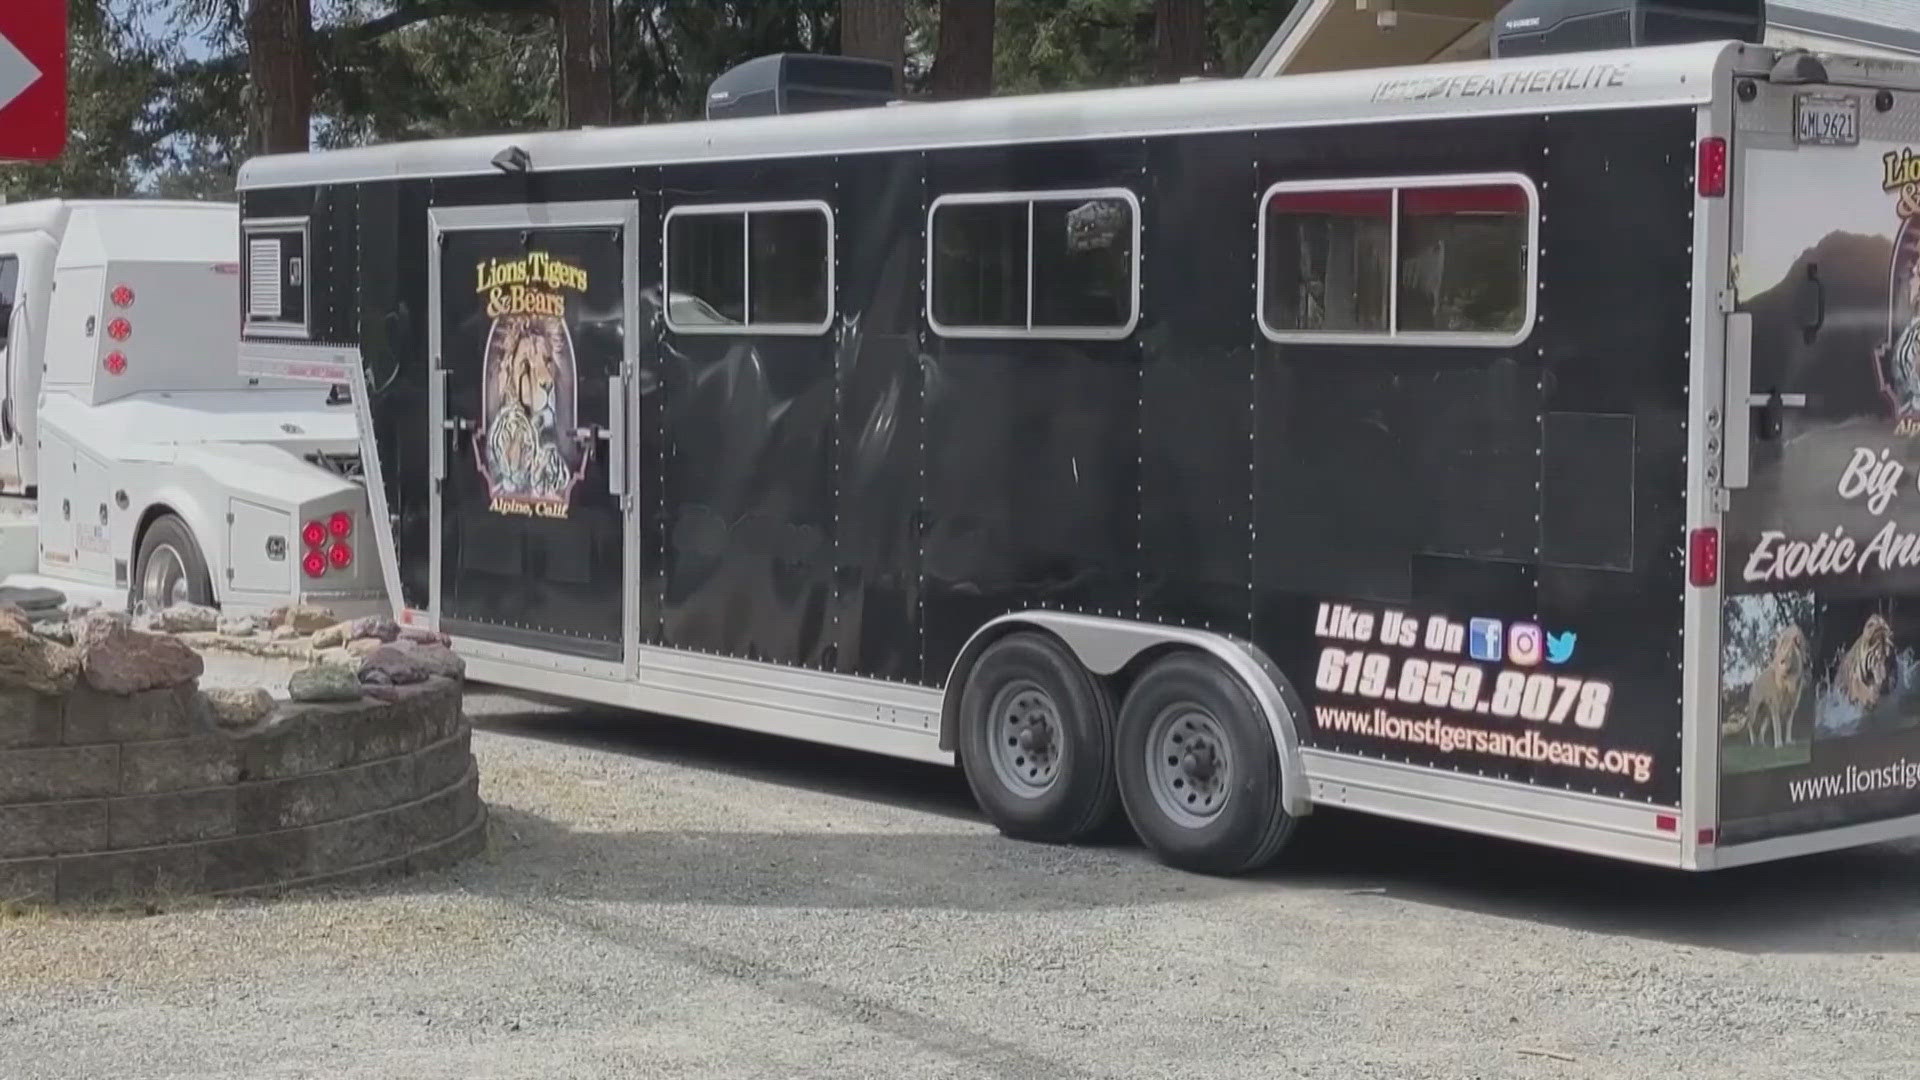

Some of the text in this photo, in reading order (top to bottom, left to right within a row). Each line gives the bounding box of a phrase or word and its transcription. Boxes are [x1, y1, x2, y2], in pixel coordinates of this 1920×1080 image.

[1443, 63, 1630, 98] FEATHERLITE
[1801, 111, 1853, 138] 4ML9621
[475, 251, 588, 294] Lions, Tigers
[487, 284, 565, 319] & Bears
[1838, 446, 1904, 516] Big
[1743, 524, 1856, 583] Exotic
[1315, 602, 1375, 642] Like
[1379, 610, 1419, 649] Us
[1424, 615, 1465, 654] On
[1315, 648, 1612, 729] 619.659.8078
[1314, 705, 1653, 784] www.lionstigersandbears.org
